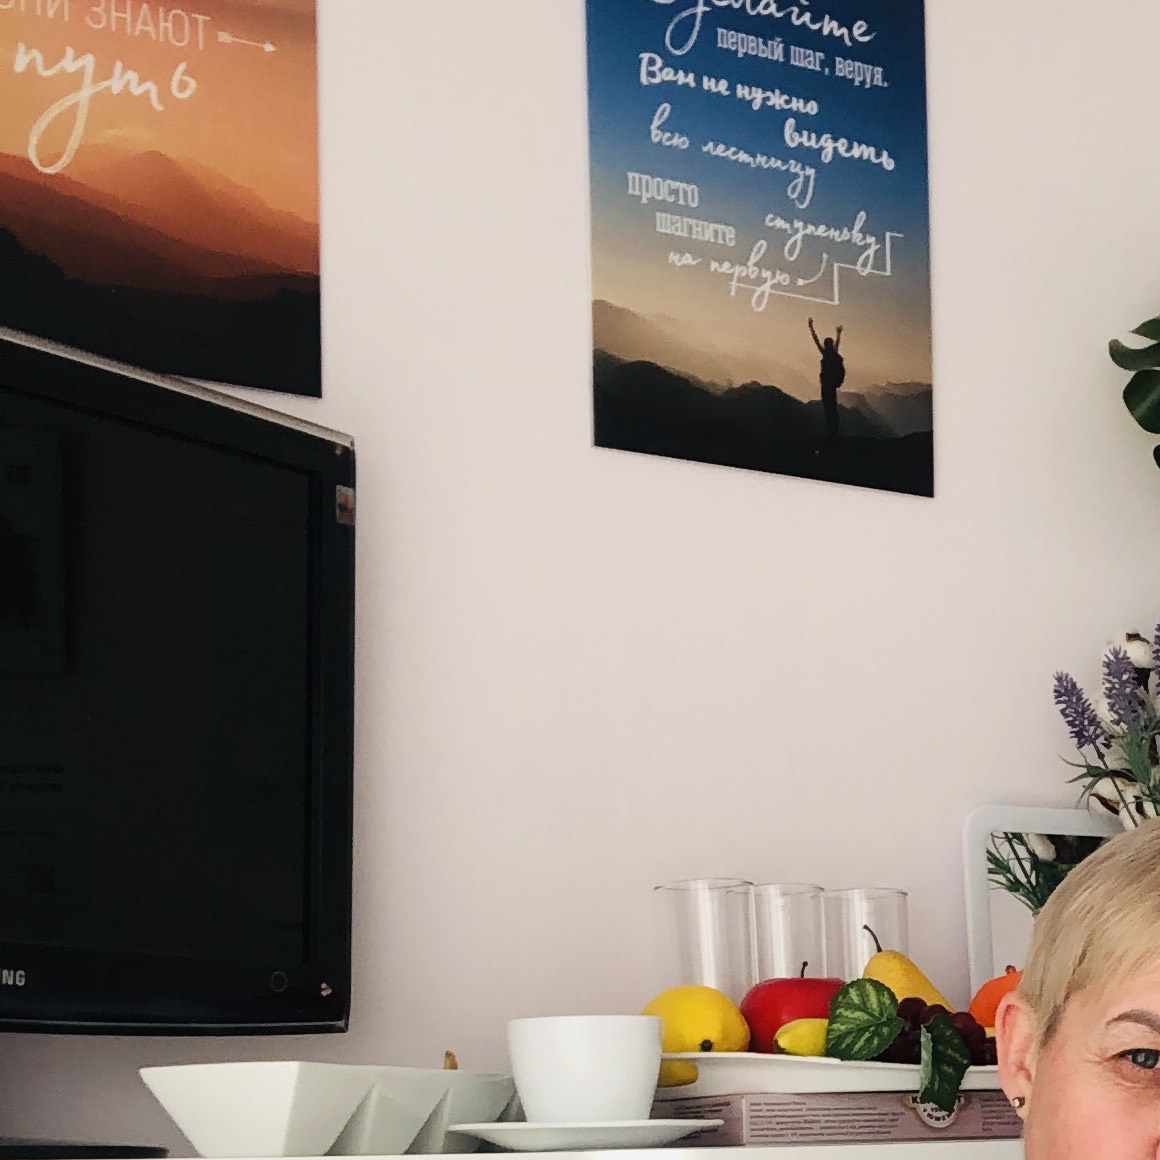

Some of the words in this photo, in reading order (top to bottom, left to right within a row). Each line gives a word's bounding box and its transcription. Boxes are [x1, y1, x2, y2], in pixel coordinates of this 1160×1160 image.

[86, 0, 211, 50] ЗНАЮТ
[716, 27, 785, 62] первый
[13, 42, 197, 174] путь
[703, 76, 730, 96] не
[735, 82, 819, 116] нужно
[650, 102, 689, 150] всю
[701, 140, 815, 209] лестницу
[784, 117, 895, 171] видеть
[627, 171, 699, 208] просто
[656, 212, 736, 247] шагните
[668, 251, 701, 266] на
[710, 239, 790, 312] первую
[2, 969, 26, 986] NG
